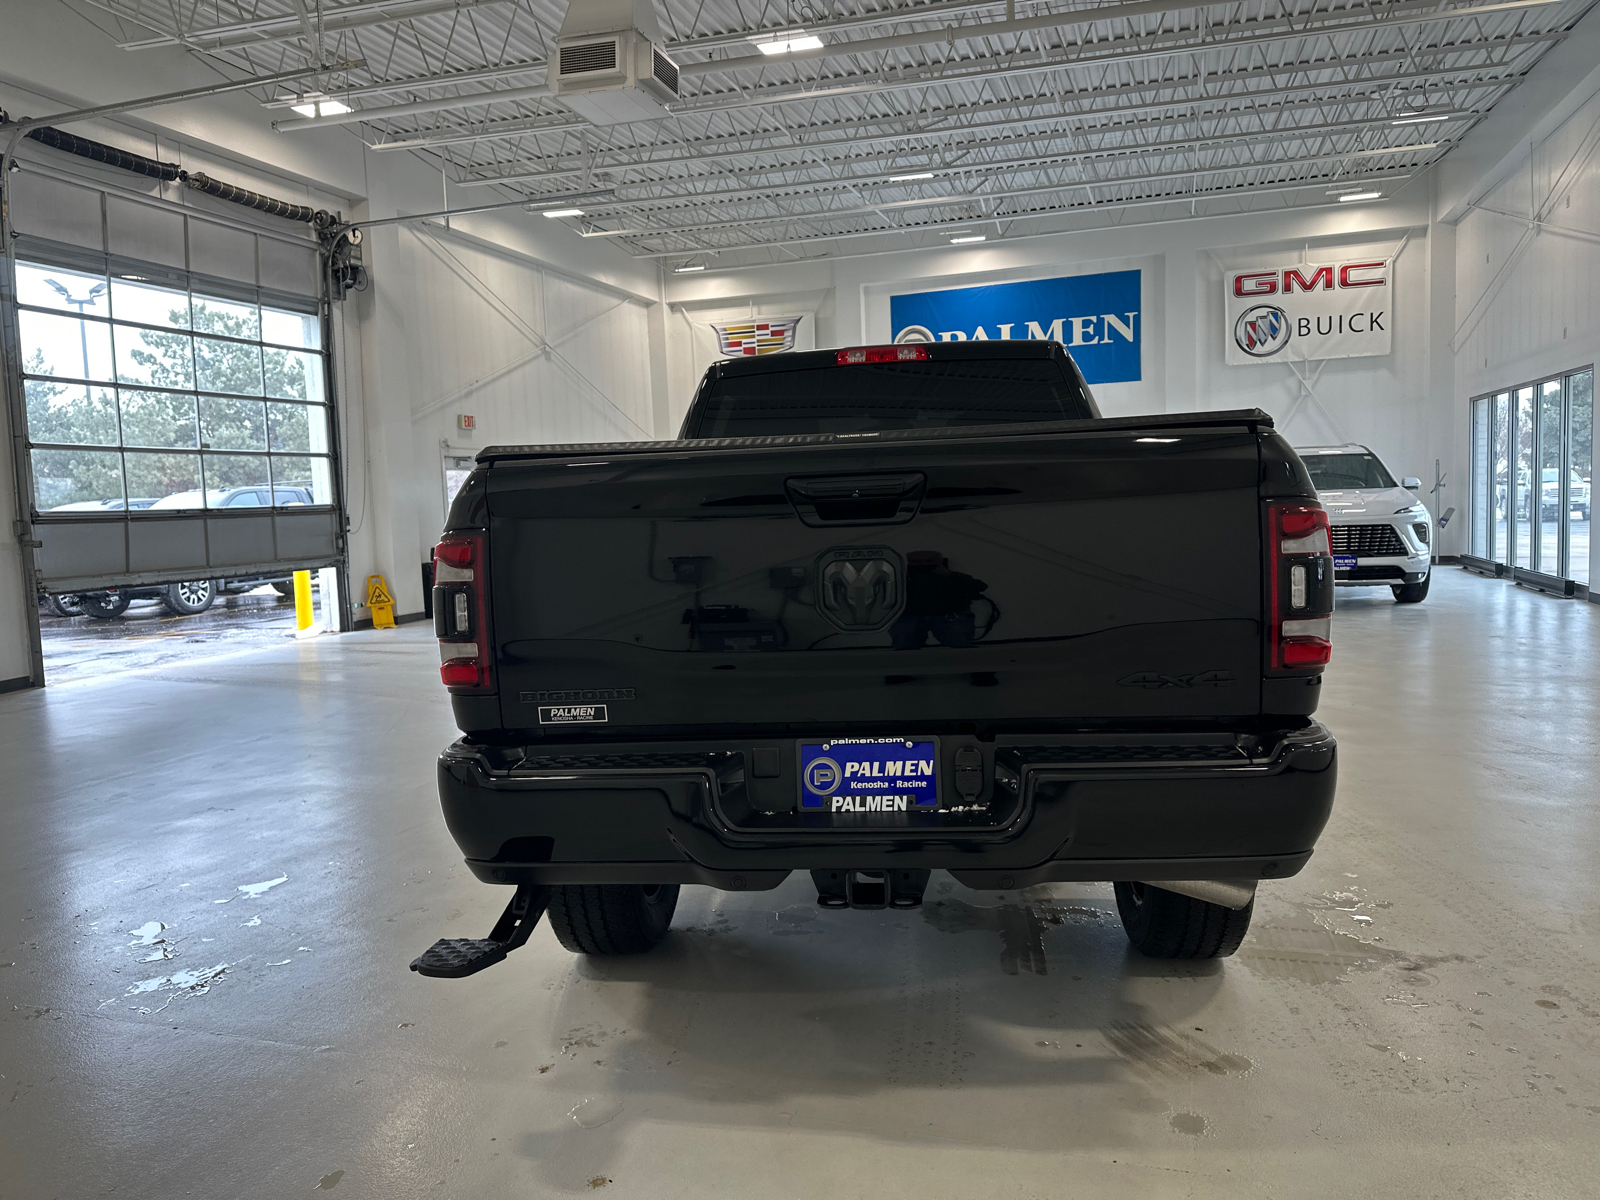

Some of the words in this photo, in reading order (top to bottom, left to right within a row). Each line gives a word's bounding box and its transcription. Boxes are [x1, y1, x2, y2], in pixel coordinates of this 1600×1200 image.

[1233, 260, 1387, 298] GMC
[1297, 311, 1385, 337] BUICK
[834, 550, 883, 559] RAM
[519, 688, 636, 703] BIGHORN
[550, 707, 595, 717] PALMEN
[830, 737, 904, 746] palmen.com
[844, 760, 934, 777] PALMEN
[850, 781, 889, 789] Kenosha
[896, 780, 927, 788] Racine
[831, 795, 908, 812] PALMEN
